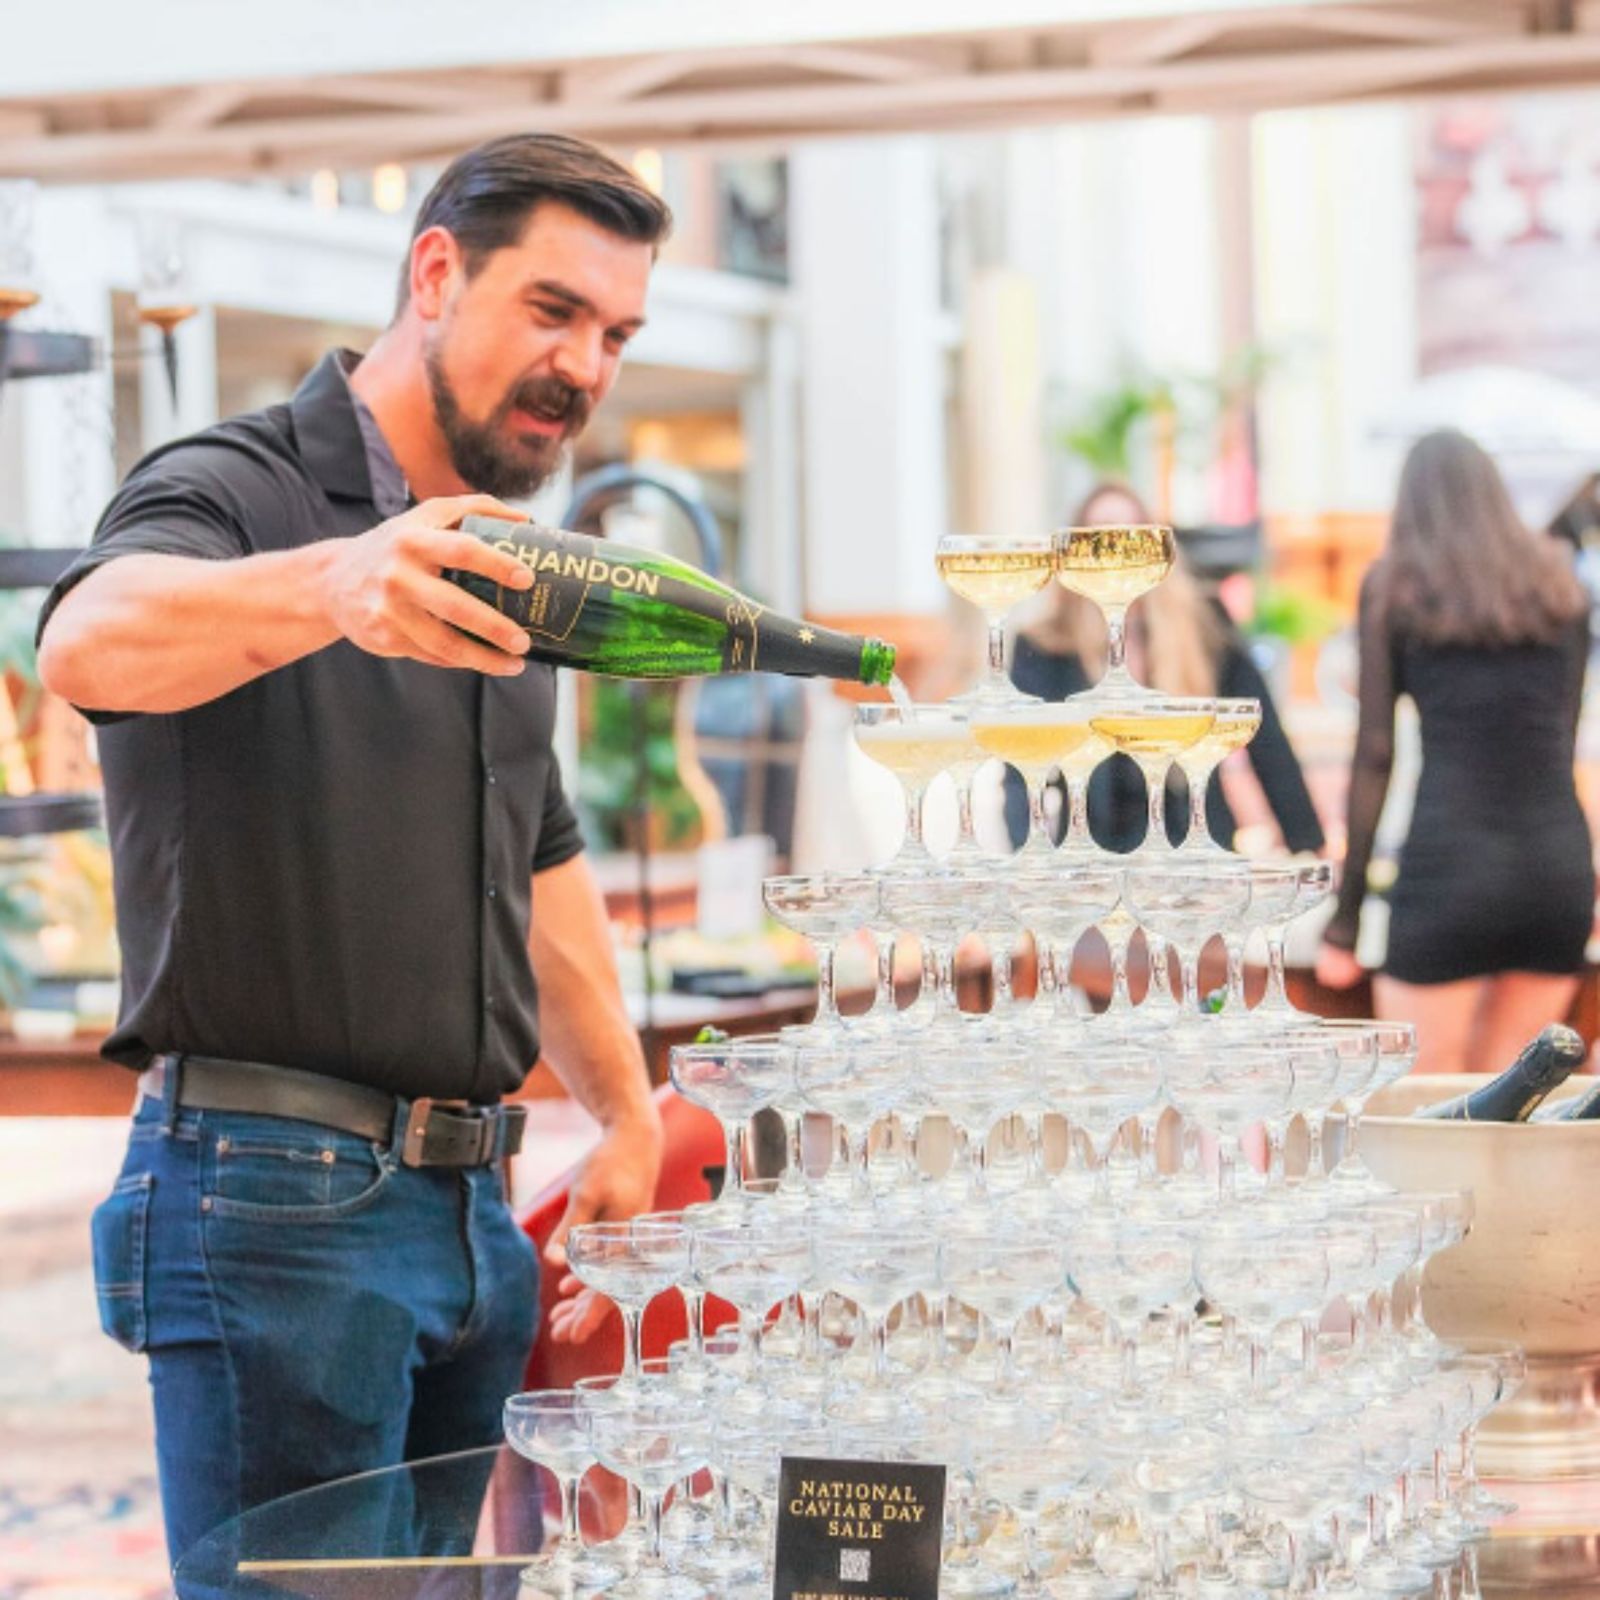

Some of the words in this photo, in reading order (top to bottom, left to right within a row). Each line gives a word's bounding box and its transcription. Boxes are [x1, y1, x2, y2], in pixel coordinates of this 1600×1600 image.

[801, 1480, 917, 1502] NATIONAL
[790, 1499, 872, 1519] CAVIAR
[883, 1504, 925, 1522] DAY
[828, 1520, 883, 1539] SALE
